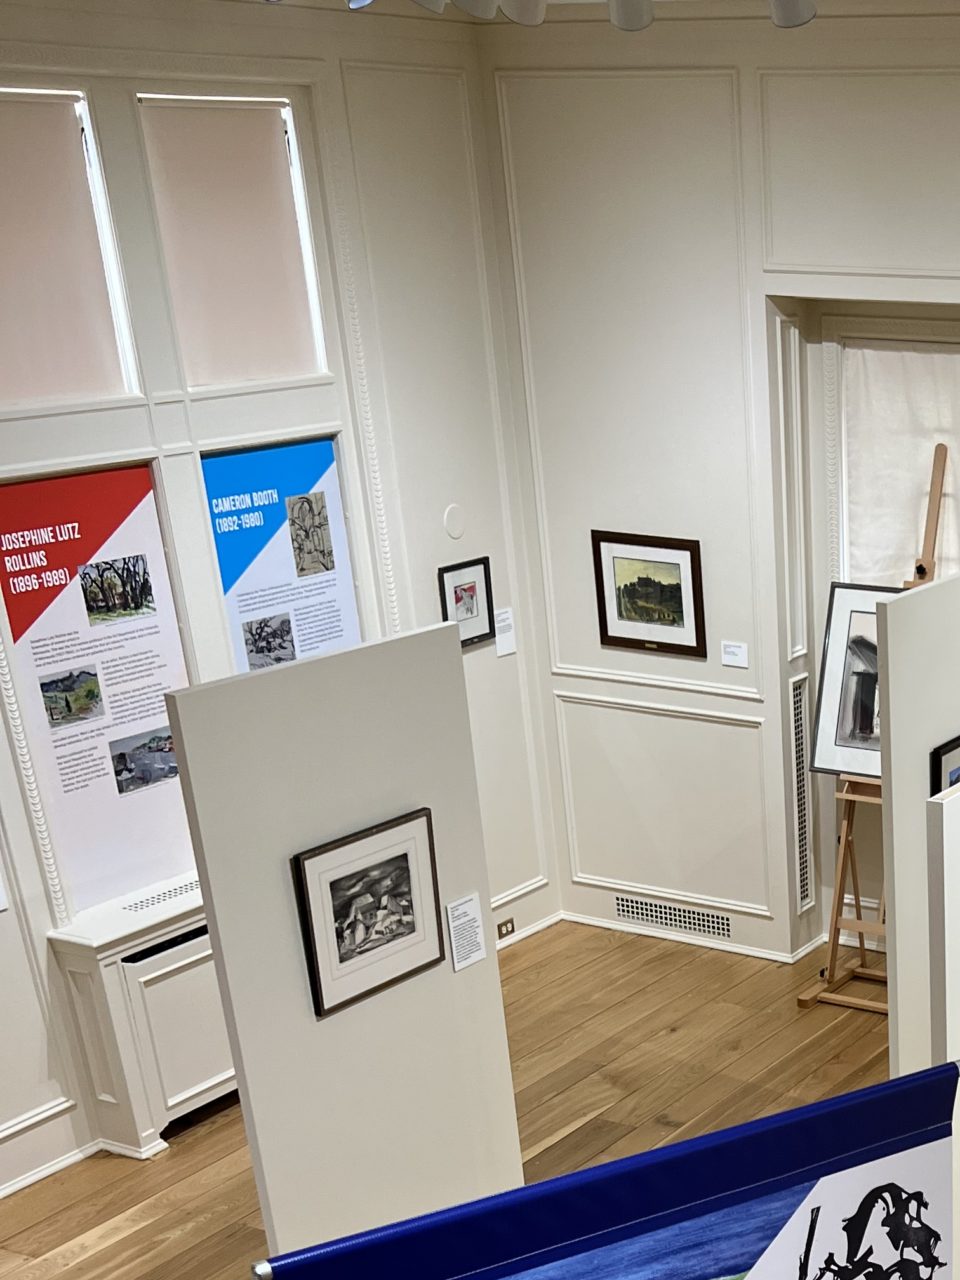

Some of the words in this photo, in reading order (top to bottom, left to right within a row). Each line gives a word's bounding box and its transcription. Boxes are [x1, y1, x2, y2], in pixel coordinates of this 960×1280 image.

[212, 493, 252, 514] CAMERON
[252, 488, 279, 507] BOOTH
[215, 510, 264, 534] (1892-1980)
[1, 526, 55, 551] JOSEPHINE
[56, 522, 81, 542] LUTZ
[4, 550, 47, 573] ROLLINS
[9, 567, 70, 594] (1896-1989)
